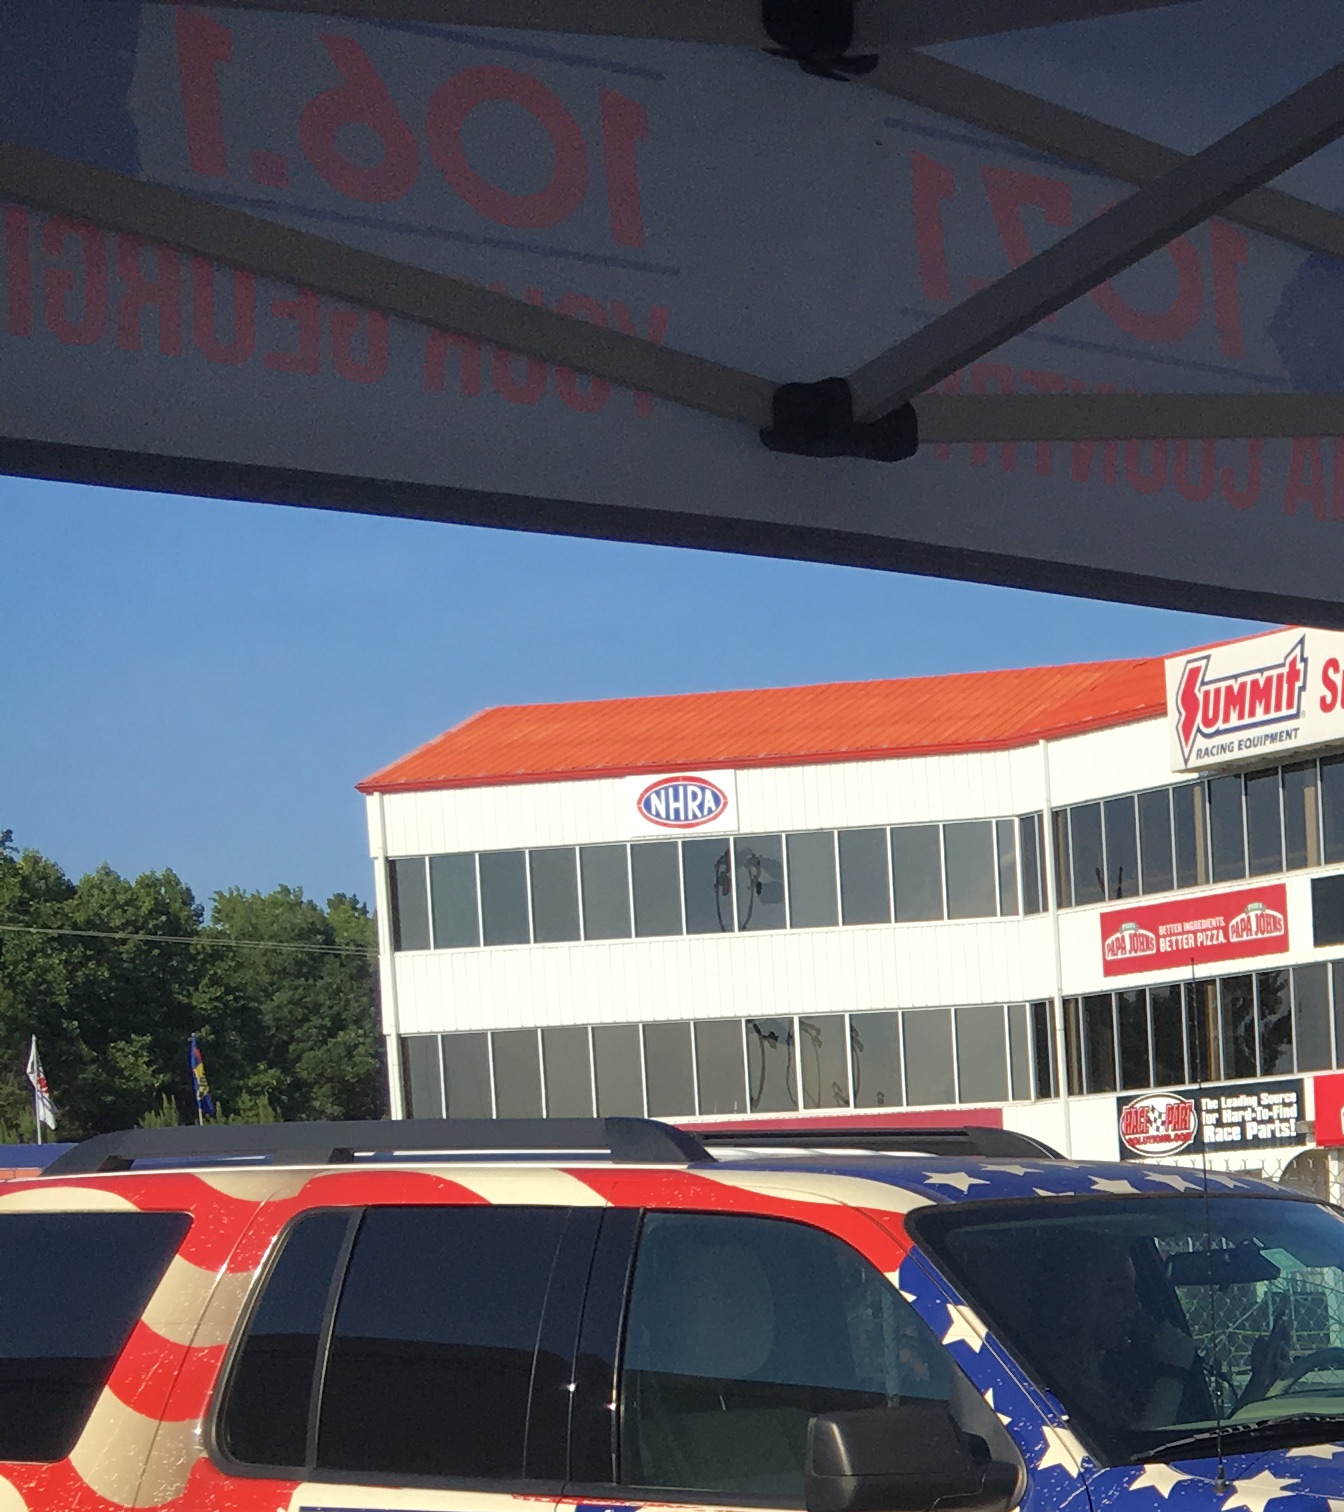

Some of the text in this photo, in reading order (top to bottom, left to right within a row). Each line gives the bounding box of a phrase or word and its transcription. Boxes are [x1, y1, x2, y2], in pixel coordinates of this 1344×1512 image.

[1196, 727, 1300, 760] RACING EQUIPMENT
[650, 785, 717, 821] NHRA
[1159, 923, 1182, 936] BETTER
[1231, 914, 1253, 939] PAPA
[1106, 934, 1127, 957] PAPA
[1160, 929, 1227, 952] BETTER PIZZA.
[1202, 1092, 1297, 1110] The Leading Source
[1124, 1102, 1193, 1135] RACE PART
[1202, 1104, 1297, 1125] for Hard-To-Find
[1204, 1120, 1296, 1142] Race Parts!
